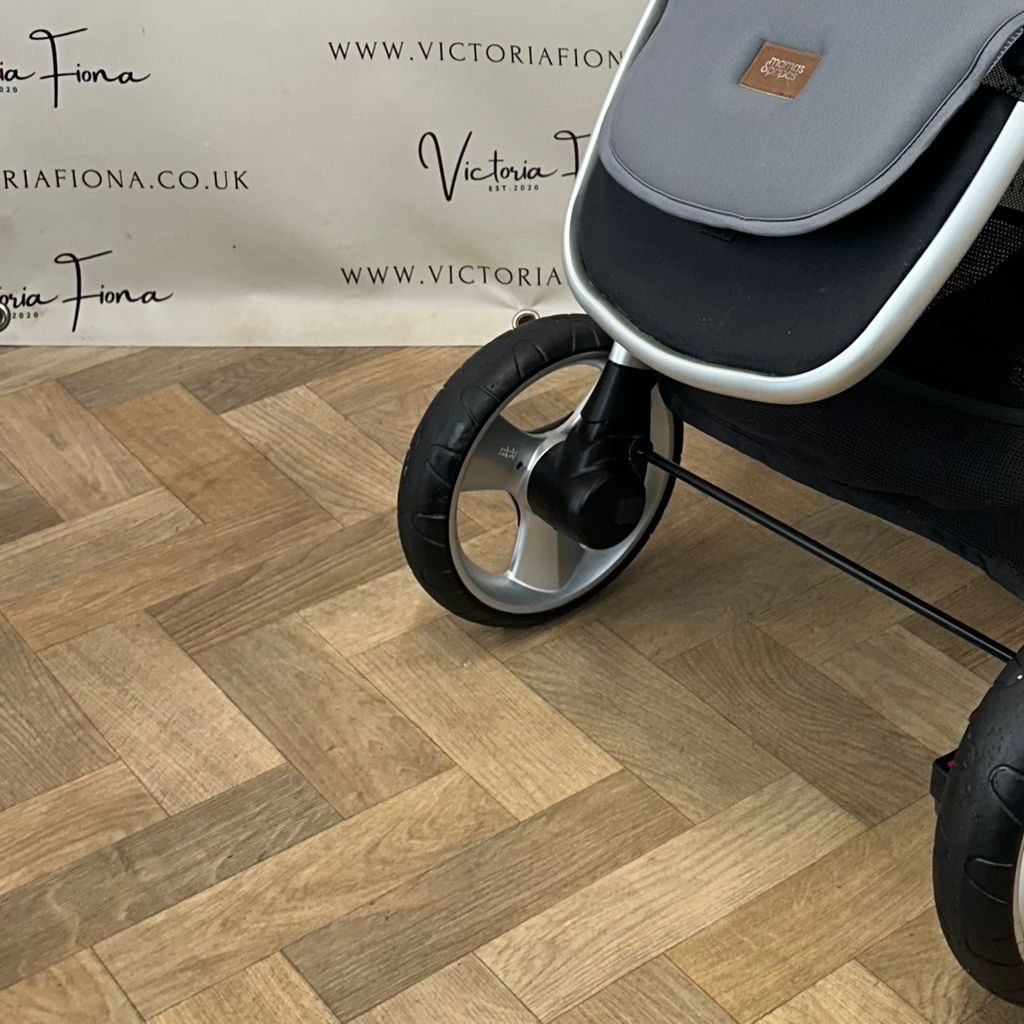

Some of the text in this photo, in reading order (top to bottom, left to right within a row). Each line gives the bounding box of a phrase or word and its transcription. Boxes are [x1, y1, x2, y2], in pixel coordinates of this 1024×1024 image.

[29, 27, 151, 108] Fiona
[328, 41, 624, 69] WWW.VICTORIAFION
[417, 131, 559, 202] Victoria
[488, 184, 540, 192] EST.2020
[53, 250, 174, 333] Fiona
[340, 264, 563, 287] WWW.VICTORIA
